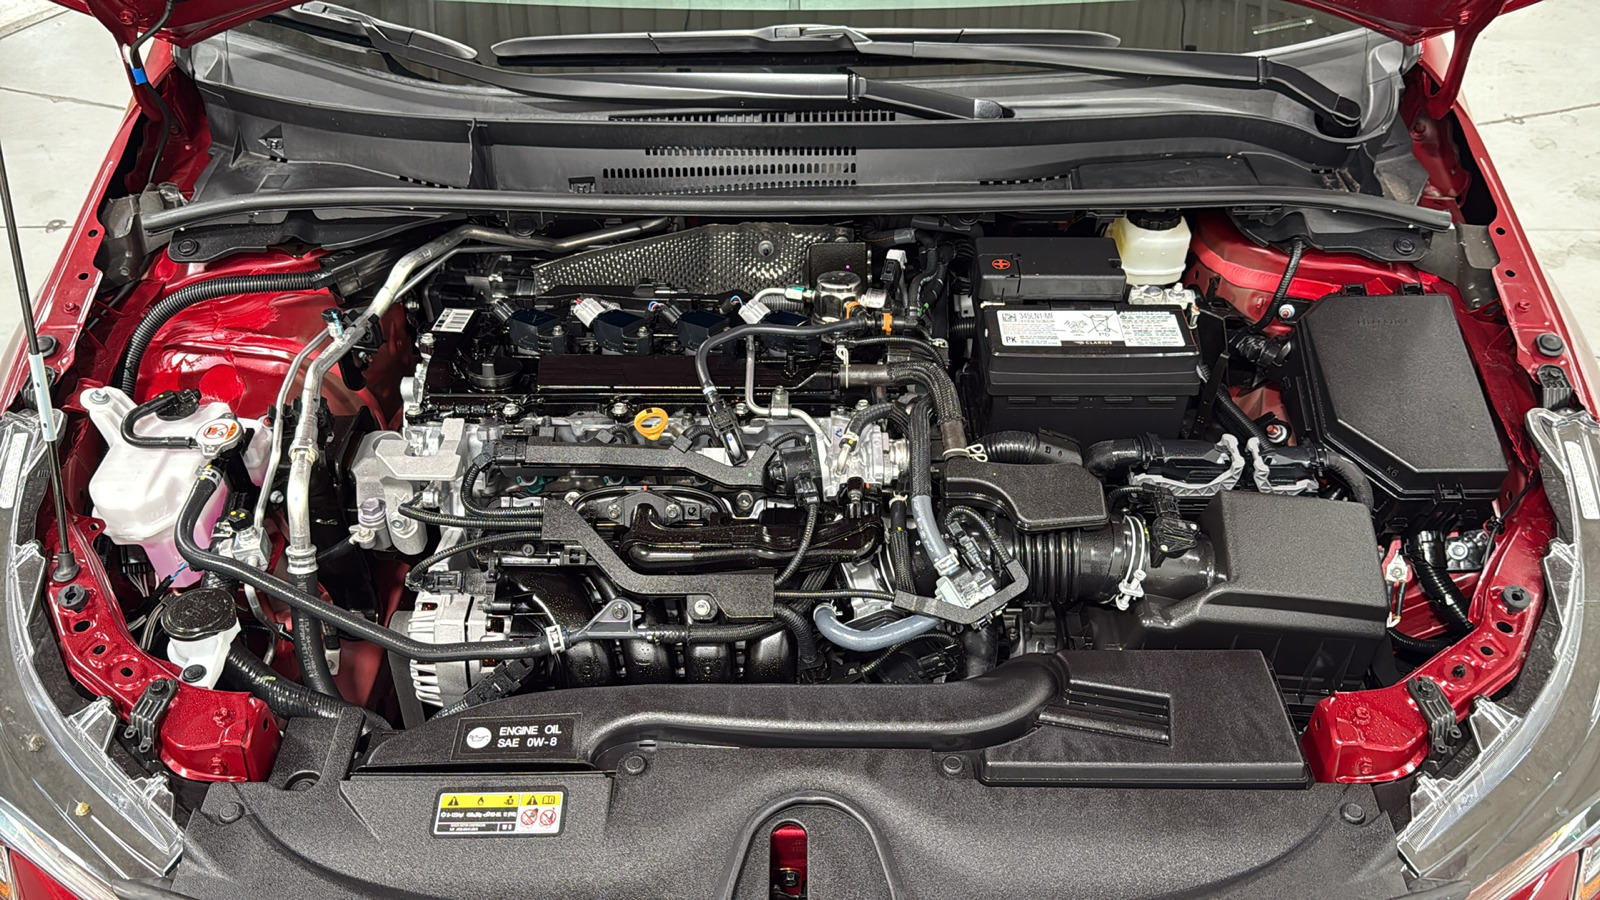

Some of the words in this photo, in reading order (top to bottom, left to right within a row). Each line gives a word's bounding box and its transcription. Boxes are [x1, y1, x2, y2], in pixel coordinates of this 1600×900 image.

[1386, 465, 1399, 477] K6
[499, 725, 539, 736] ENGINE
[544, 724, 562, 734] OIL
[497, 737, 520, 748] SAE
[526, 737, 558, 747] 0W-8
